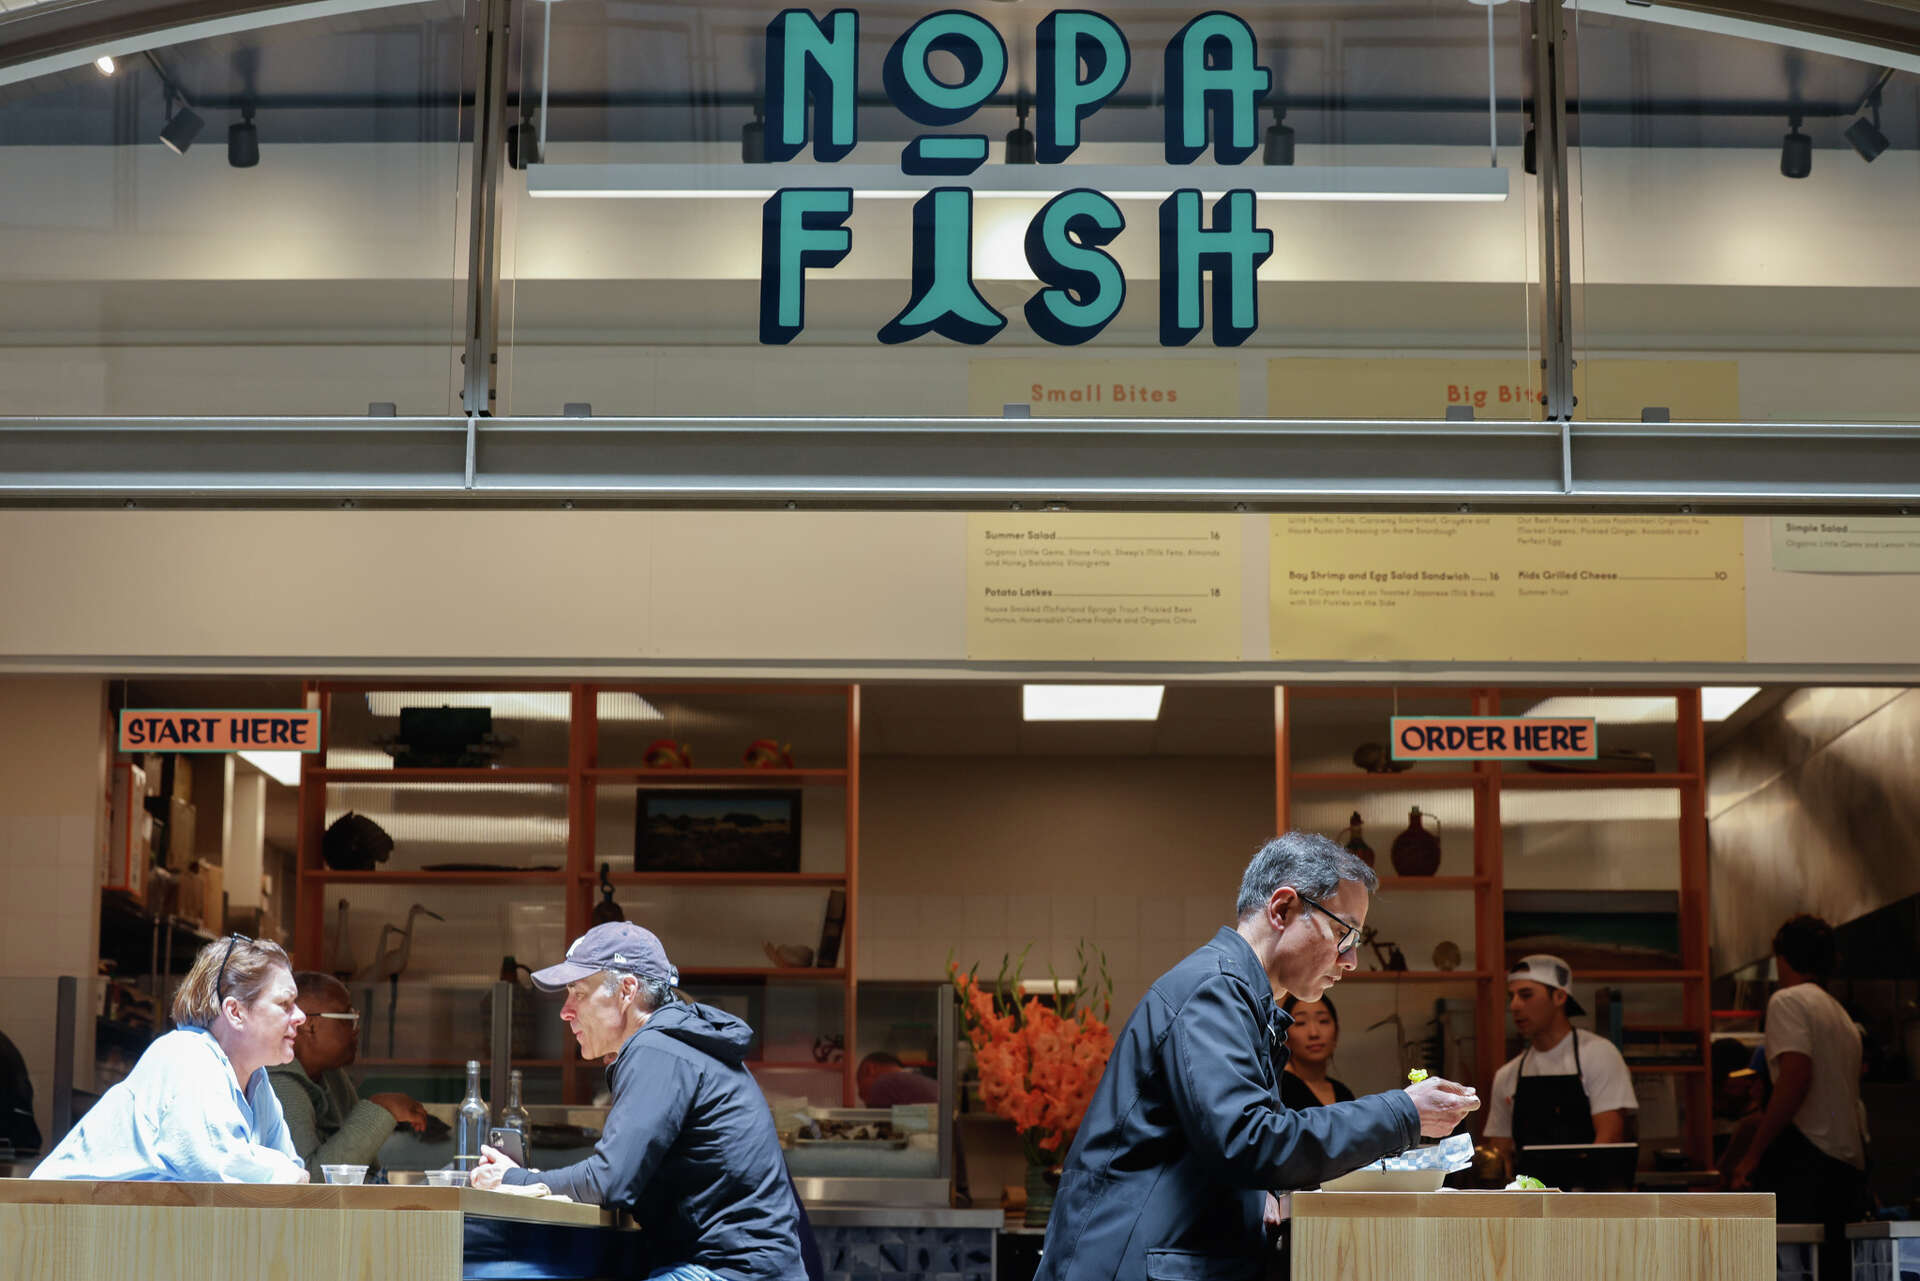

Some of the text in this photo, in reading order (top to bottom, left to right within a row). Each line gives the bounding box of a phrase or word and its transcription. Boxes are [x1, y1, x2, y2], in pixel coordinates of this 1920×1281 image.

[764, 8, 1272, 175] NOPA
[760, 187, 1274, 346] FISH
[1031, 384, 1177, 402] Small Bites
[1447, 385, 1487, 407] Big
[985, 530, 1221, 541] Summer Salad 16
[1786, 523, 1848, 534] Simple Salad
[1289, 571, 1500, 582] Bay Shrimp and Egg Salad Sandwich 16
[1518, 571, 1728, 581] Kids Grilled Cheese 10
[985, 588, 1221, 598] Potato Latkes 18
[128, 718, 309, 744] START HERE
[1401, 725, 1588, 751] ORDER HERE
